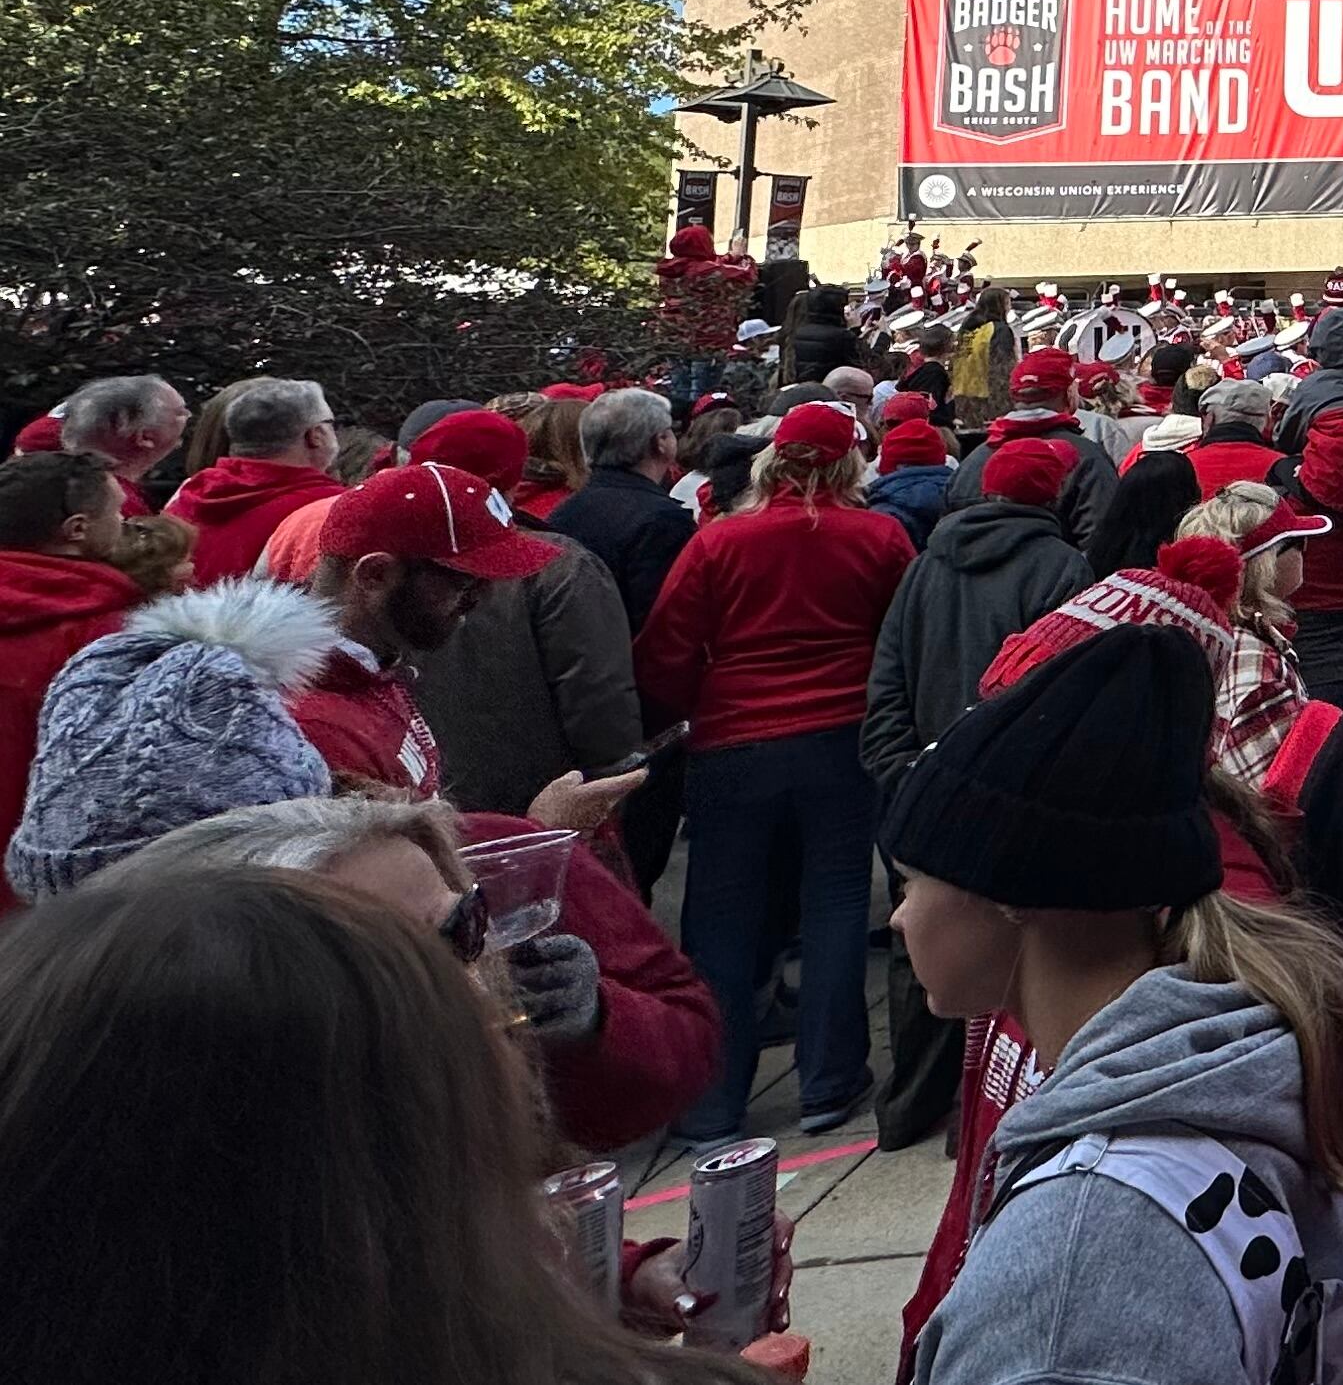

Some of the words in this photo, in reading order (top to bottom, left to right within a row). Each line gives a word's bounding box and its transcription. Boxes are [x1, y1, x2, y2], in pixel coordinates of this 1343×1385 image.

[1228, 20, 1252, 35] THE
[1104, 39, 1138, 65] UW
[1145, 38, 1251, 65] MARCHING
[949, 62, 1056, 113] BASH
[1100, 68, 1249, 135] BAND
[966, 186, 977, 197] A
[981, 185, 1055, 197] WISCONSIN
[1059, 184, 1102, 196] UNION
[1106, 183, 1184, 196] EXPERIENCE
